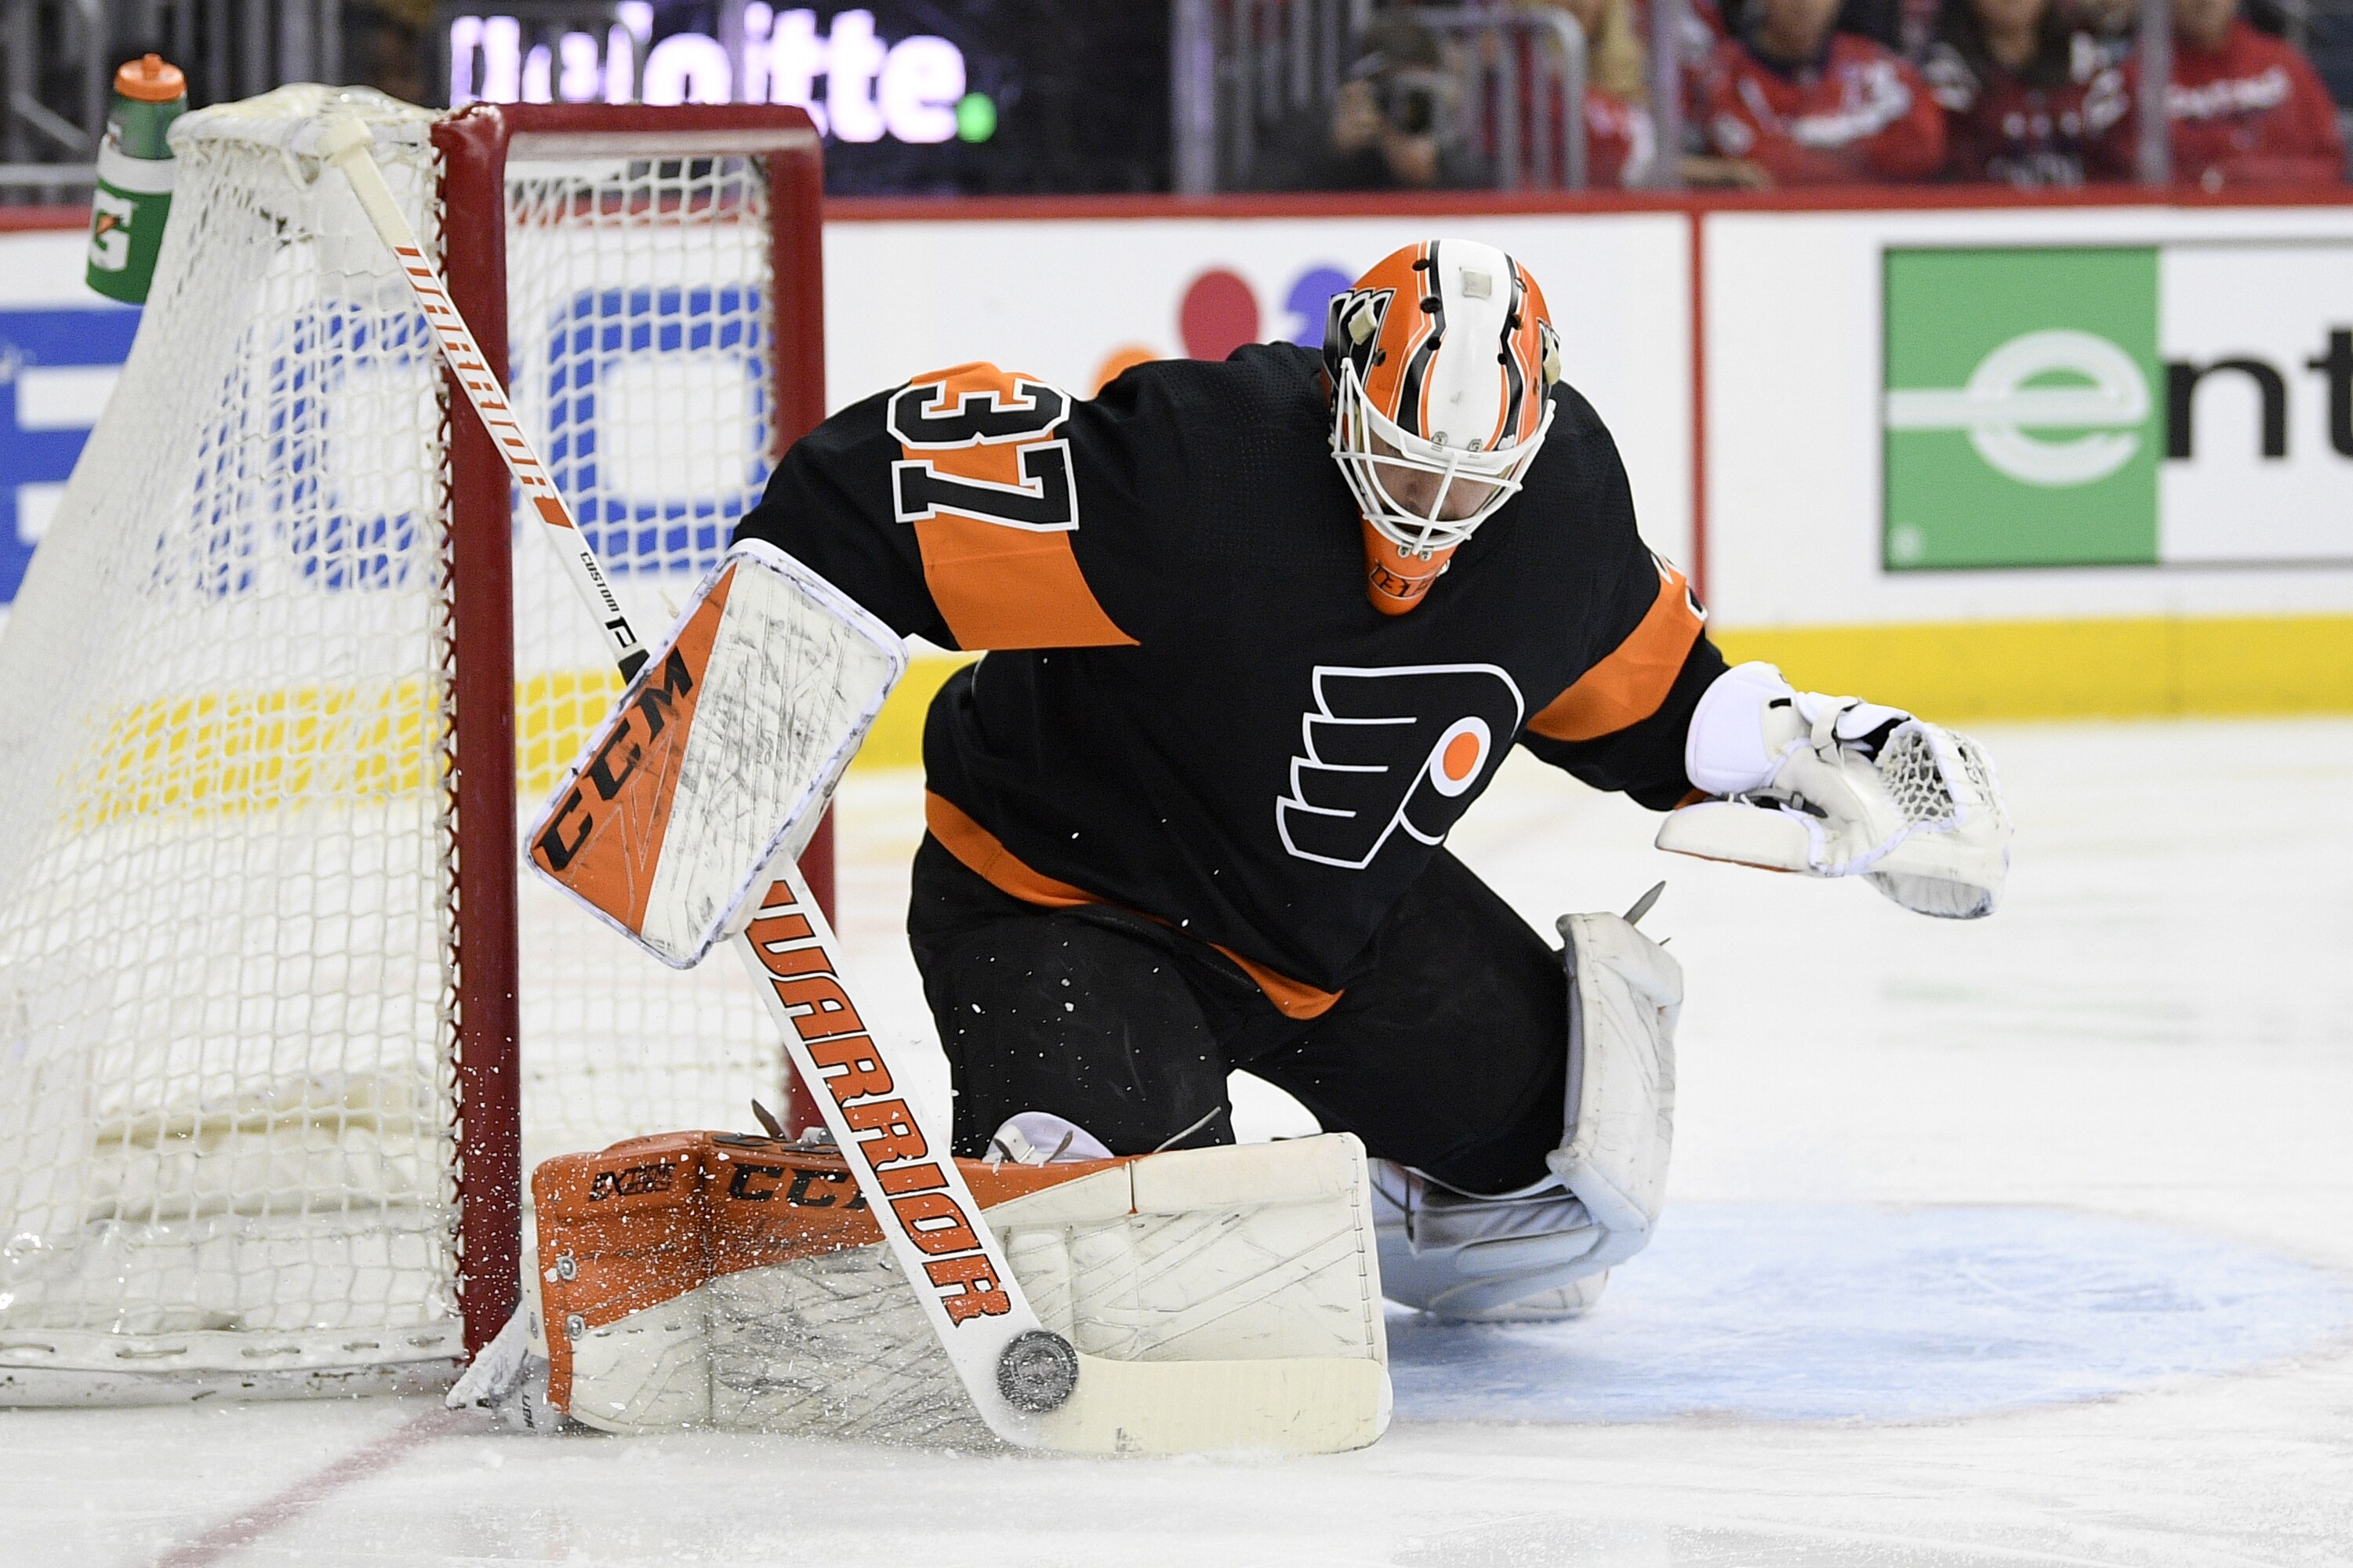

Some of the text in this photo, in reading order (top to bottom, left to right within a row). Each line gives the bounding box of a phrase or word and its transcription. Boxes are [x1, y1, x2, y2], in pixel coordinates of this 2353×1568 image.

[887, 378, 1080, 533] 37
[579, 551, 619, 612] CUSTOM
[532, 644, 693, 873] CCM
[728, 1163, 867, 1210] CC
